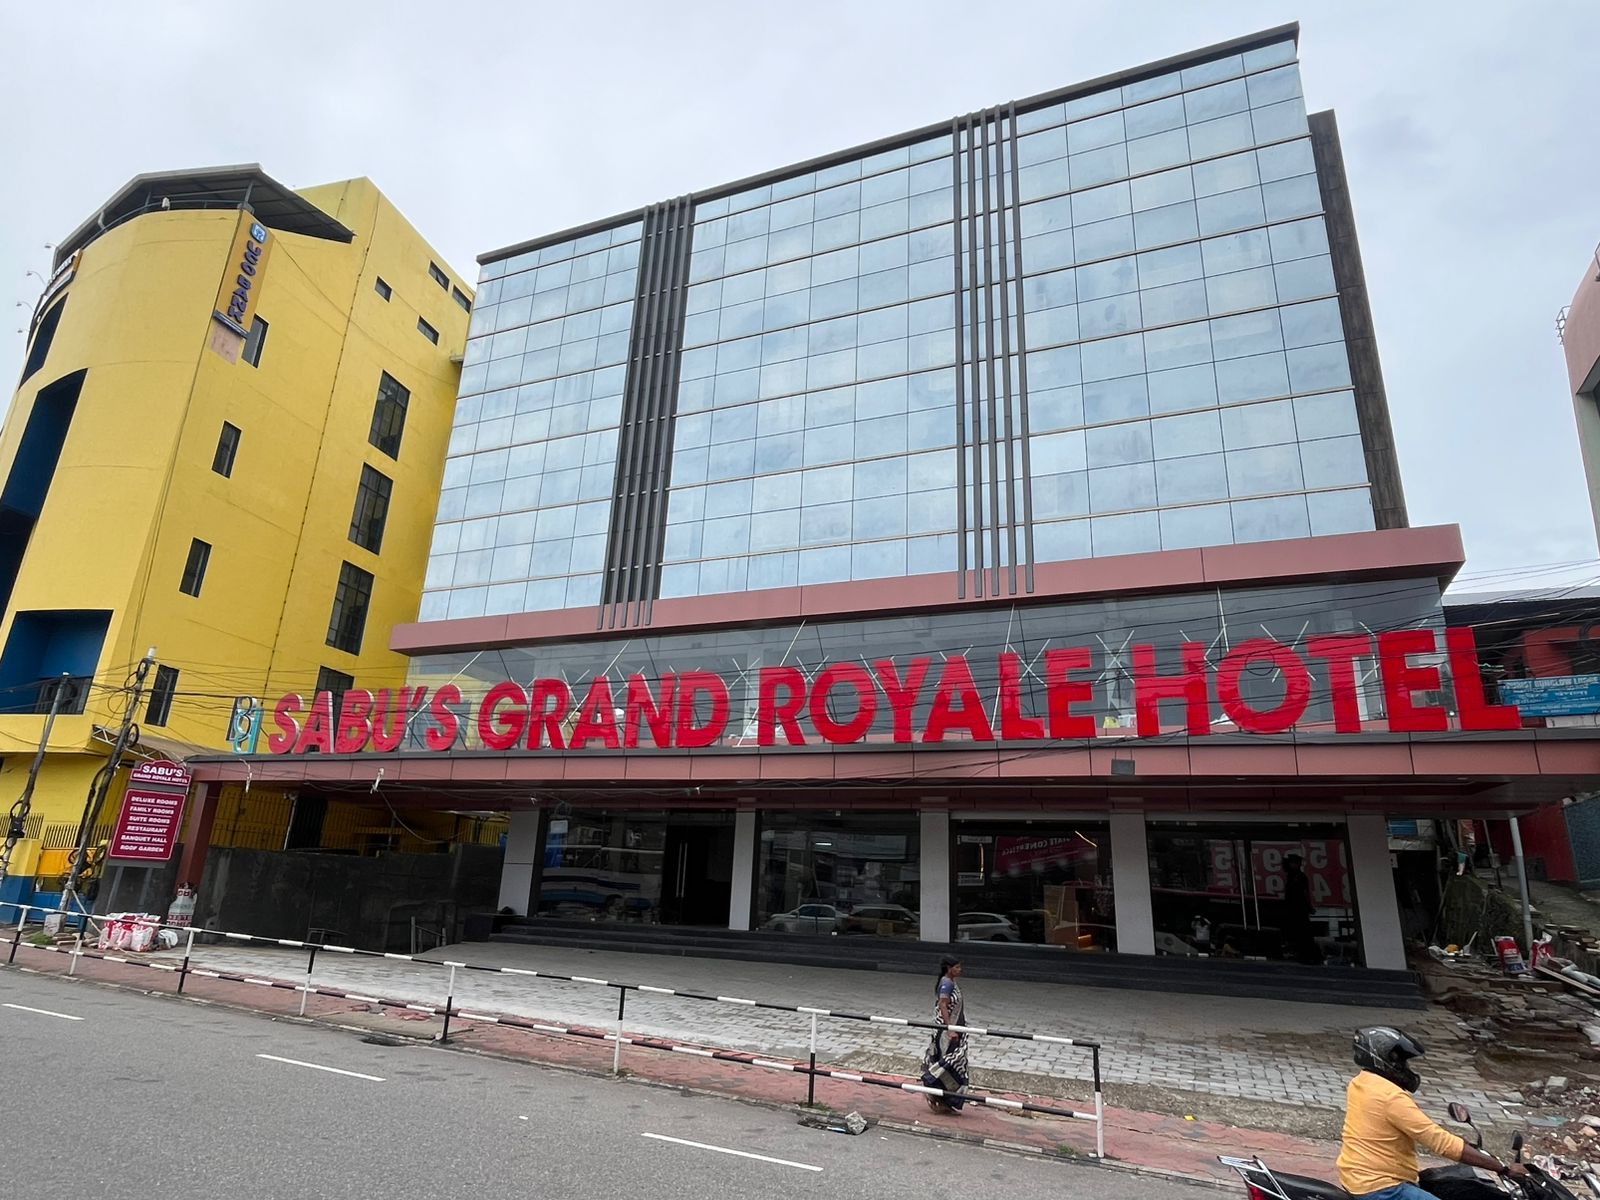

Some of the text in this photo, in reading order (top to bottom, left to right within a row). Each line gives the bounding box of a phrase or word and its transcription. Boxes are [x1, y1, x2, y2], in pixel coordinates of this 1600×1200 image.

[227, 240, 262, 323] UCO BANK
[268, 625, 1522, 755] SABU'S GRAND ROYALE HOTEL
[142, 765, 183, 777] SABU'S
[133, 772, 152, 780] GRAND
[152, 774, 171, 782] ROYALE
[131, 796, 178, 806] DELUXE ROOMS
[129, 815, 148, 823] SUITE
[127, 825, 168, 833] RESTAURANT
[121, 834, 151, 843] BANQUET
[138, 845, 164, 853] GARDEN
